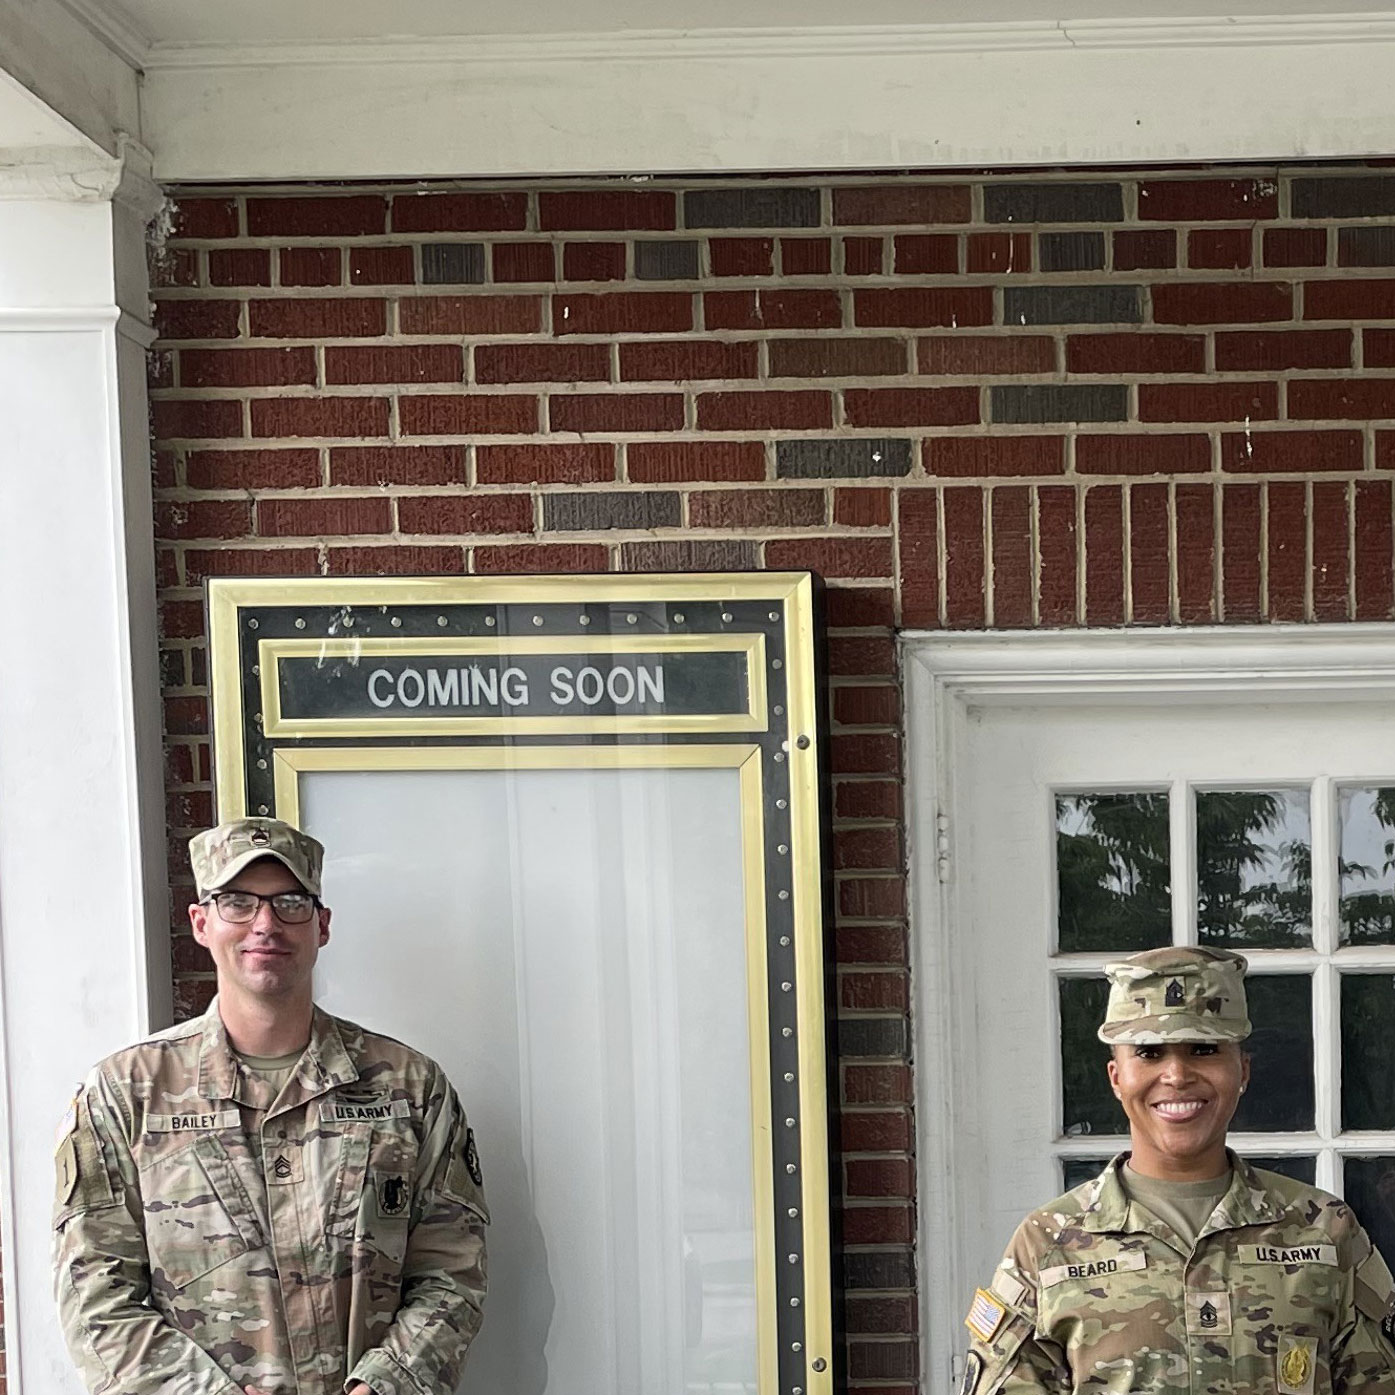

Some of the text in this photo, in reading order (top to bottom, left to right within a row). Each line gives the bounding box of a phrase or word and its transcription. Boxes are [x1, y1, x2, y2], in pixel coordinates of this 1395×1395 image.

[367, 665, 665, 708] COMING SOON
[171, 1115, 217, 1130] BAILEY
[1281, 1247, 1321, 1263] ARMY
[1068, 1259, 1117, 1279] BEARD
